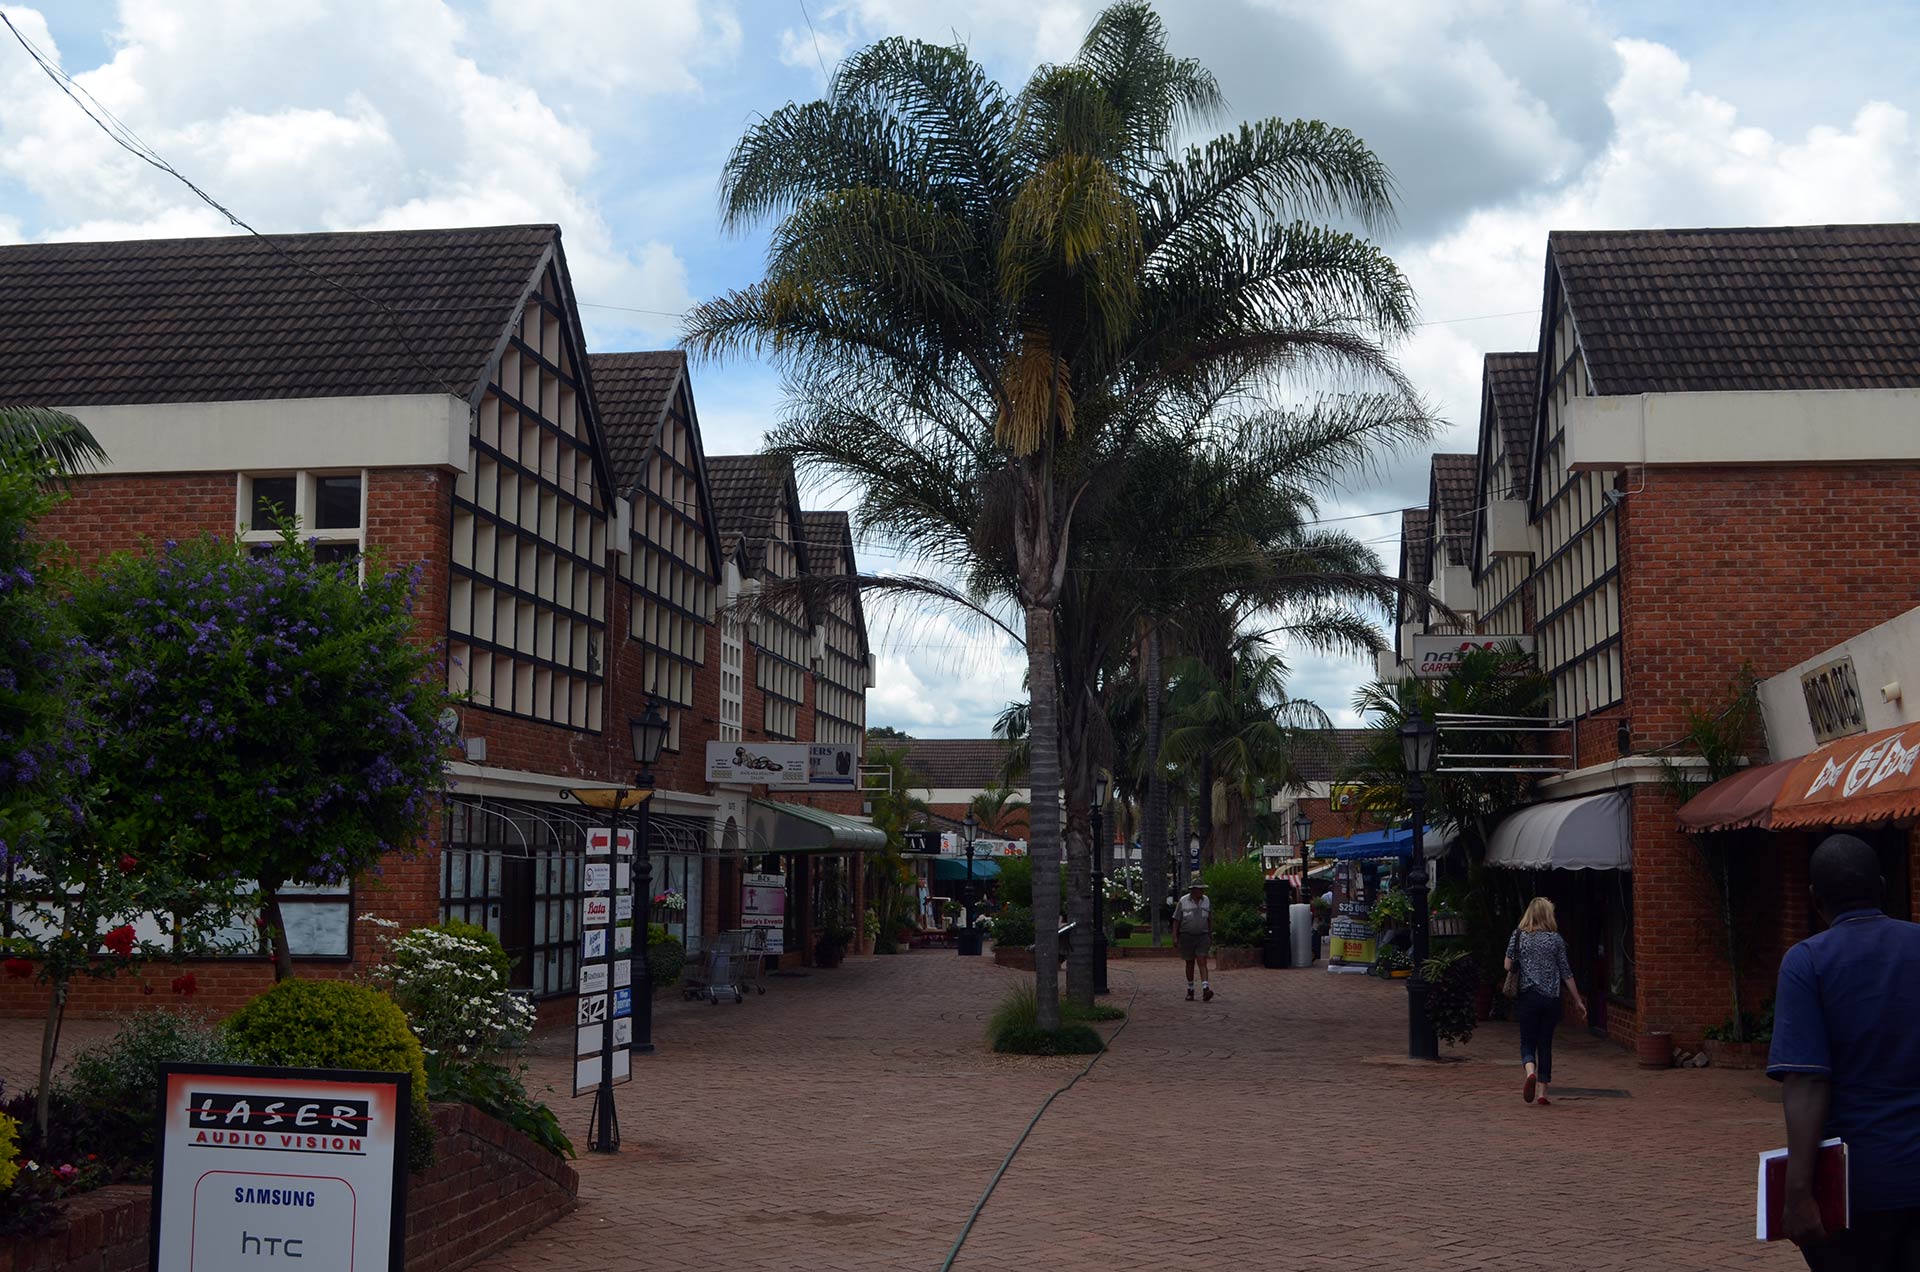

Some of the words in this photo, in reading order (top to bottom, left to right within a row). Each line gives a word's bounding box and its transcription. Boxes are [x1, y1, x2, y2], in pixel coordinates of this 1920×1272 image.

[587, 901, 606, 914] Bata
[199, 1098, 358, 1131] LASER
[196, 1130, 267, 1146] AUDIO
[280, 1134, 362, 1151] VISION
[234, 1187, 315, 1207] SAMSUNG
